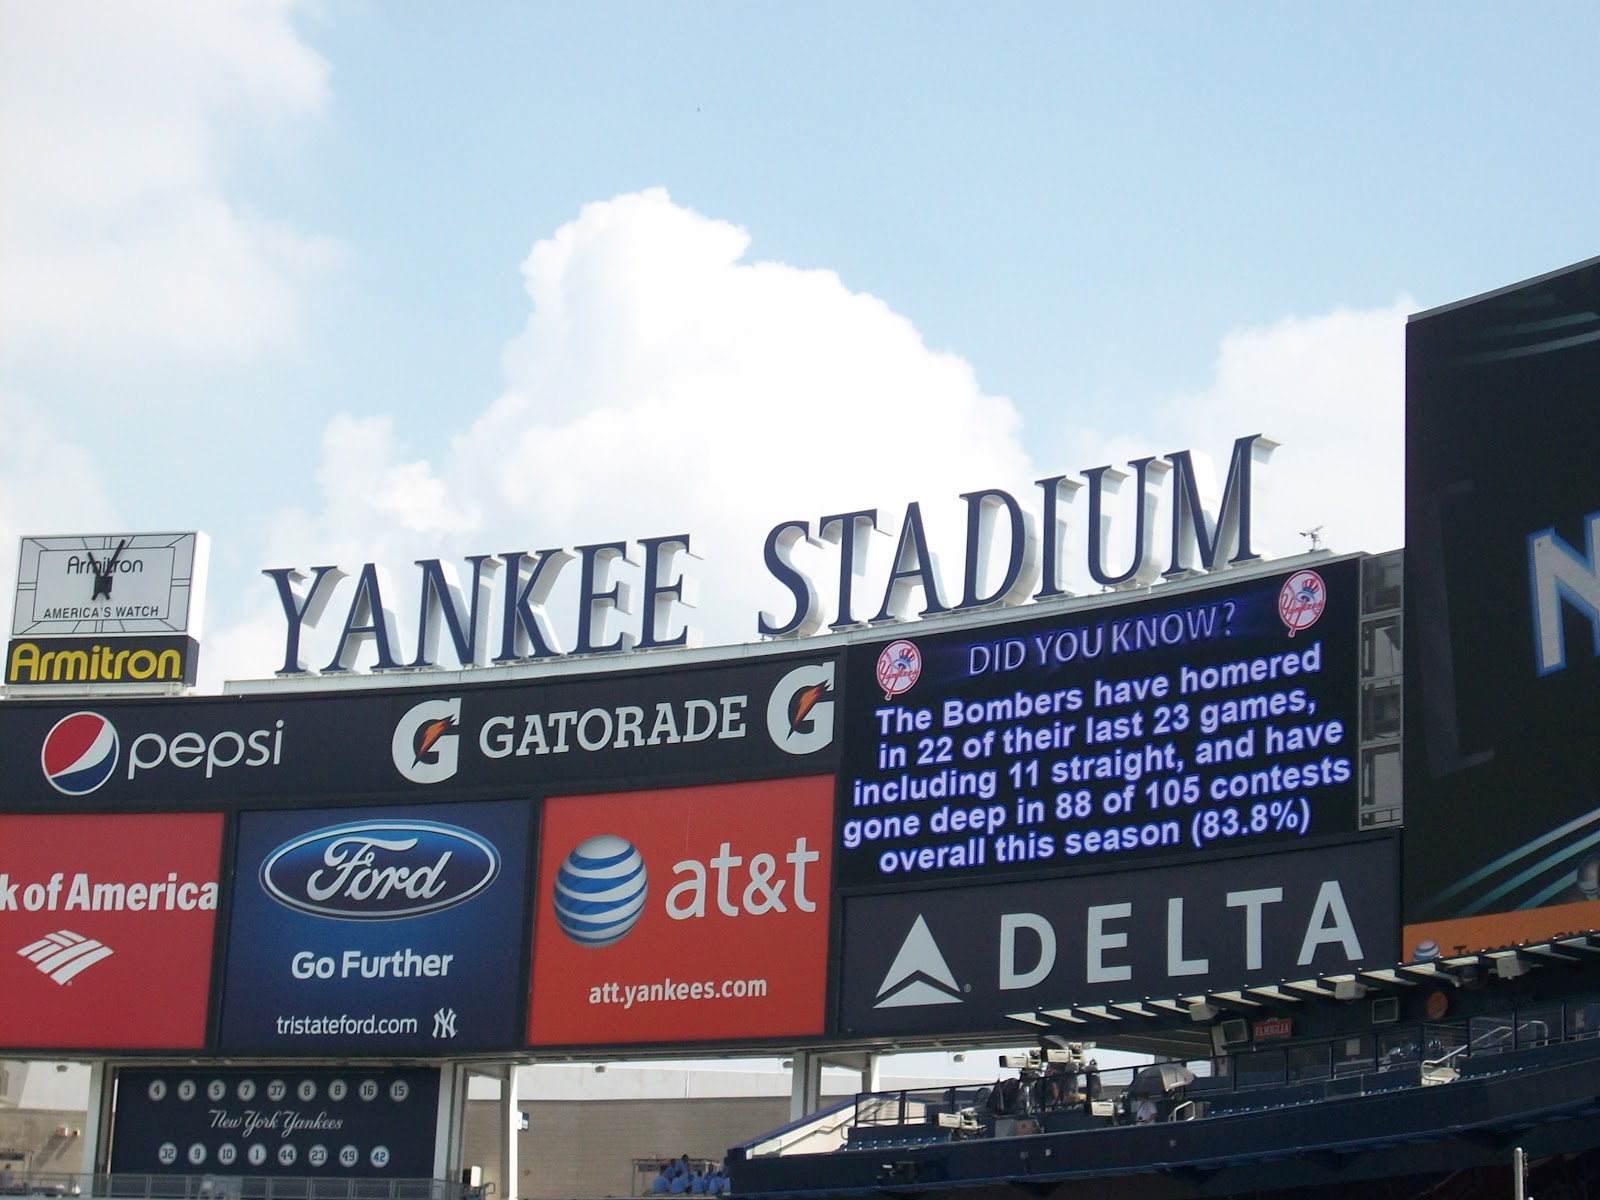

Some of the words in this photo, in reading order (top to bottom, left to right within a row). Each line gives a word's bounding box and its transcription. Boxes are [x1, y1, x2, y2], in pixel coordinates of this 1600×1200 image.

[67, 556, 143, 575] Armitron
[262, 533, 698, 675] YANKEE
[758, 433, 1276, 636] STADIUM
[43, 606, 112, 619] AMERICA'S
[115, 605, 159, 618] WATCH
[969, 639, 1026, 676] DID
[1035, 624, 1104, 665] YOU
[1111, 601, 1236, 655] KNOW?
[9, 642, 183, 681] Armitron
[876, 707, 932, 736] The
[943, 689, 1083, 728] Bombers
[1094, 675, 1169, 707] have
[1180, 642, 1321, 695] homered
[127, 719, 285, 780] pepsi
[479, 696, 748, 759] GATORADE
[879, 742, 907, 770] in
[917, 737, 952, 766] 22
[963, 730, 995, 760] of
[1003, 721, 1075, 754] their
[1086, 710, 1144, 744] last
[1153, 704, 1189, 735] 23
[1200, 689, 1316, 733] games,
[853, 769, 997, 806] including
[1009, 759, 1039, 789] 11
[1052, 743, 1185, 784] straight,
[1196, 730, 1255, 765] and
[1266, 720, 1344, 754] have
[843, 814, 920, 848] gone
[930, 804, 1006, 836] deep
[1017, 798, 1045, 825] in
[1055, 791, 1092, 820] 88
[1103, 785, 1135, 815] of
[1146, 775, 1200, 809] 105
[1210, 755, 1351, 801] contests
[879, 838, 986, 874] overall
[995, 834, 1054, 863] this
[1065, 820, 1180, 855] season
[1192, 797, 1311, 848] (83.8%)
[23, 873, 64, 911] of
[65, 873, 218, 911] America
[307, 837, 453, 901] Ford
[665, 837, 820, 920] at&t
[291, 951, 335, 979] Go
[342, 948, 453, 978] Further
[1000, 880, 1365, 990] DELTA
[277, 1014, 418, 1035] tristateford.com
[589, 978, 767, 1009] att.yankees.com
[270, 1085, 284, 1096] 37
[363, 1085, 374, 1096] 16
[393, 1085, 405, 1096] 15
[208, 1109, 242, 1128] New
[242, 1110, 282, 1138] York
[281, 1110, 343, 1138] Yankees
[161, 1148, 174, 1159] 32
[222, 1149, 233, 1160] 10
[280, 1149, 294, 1160] 44
[311, 1150, 325, 1161] 23
[342, 1151, 355, 1161] 49
[372, 1151, 386, 1162] 42
